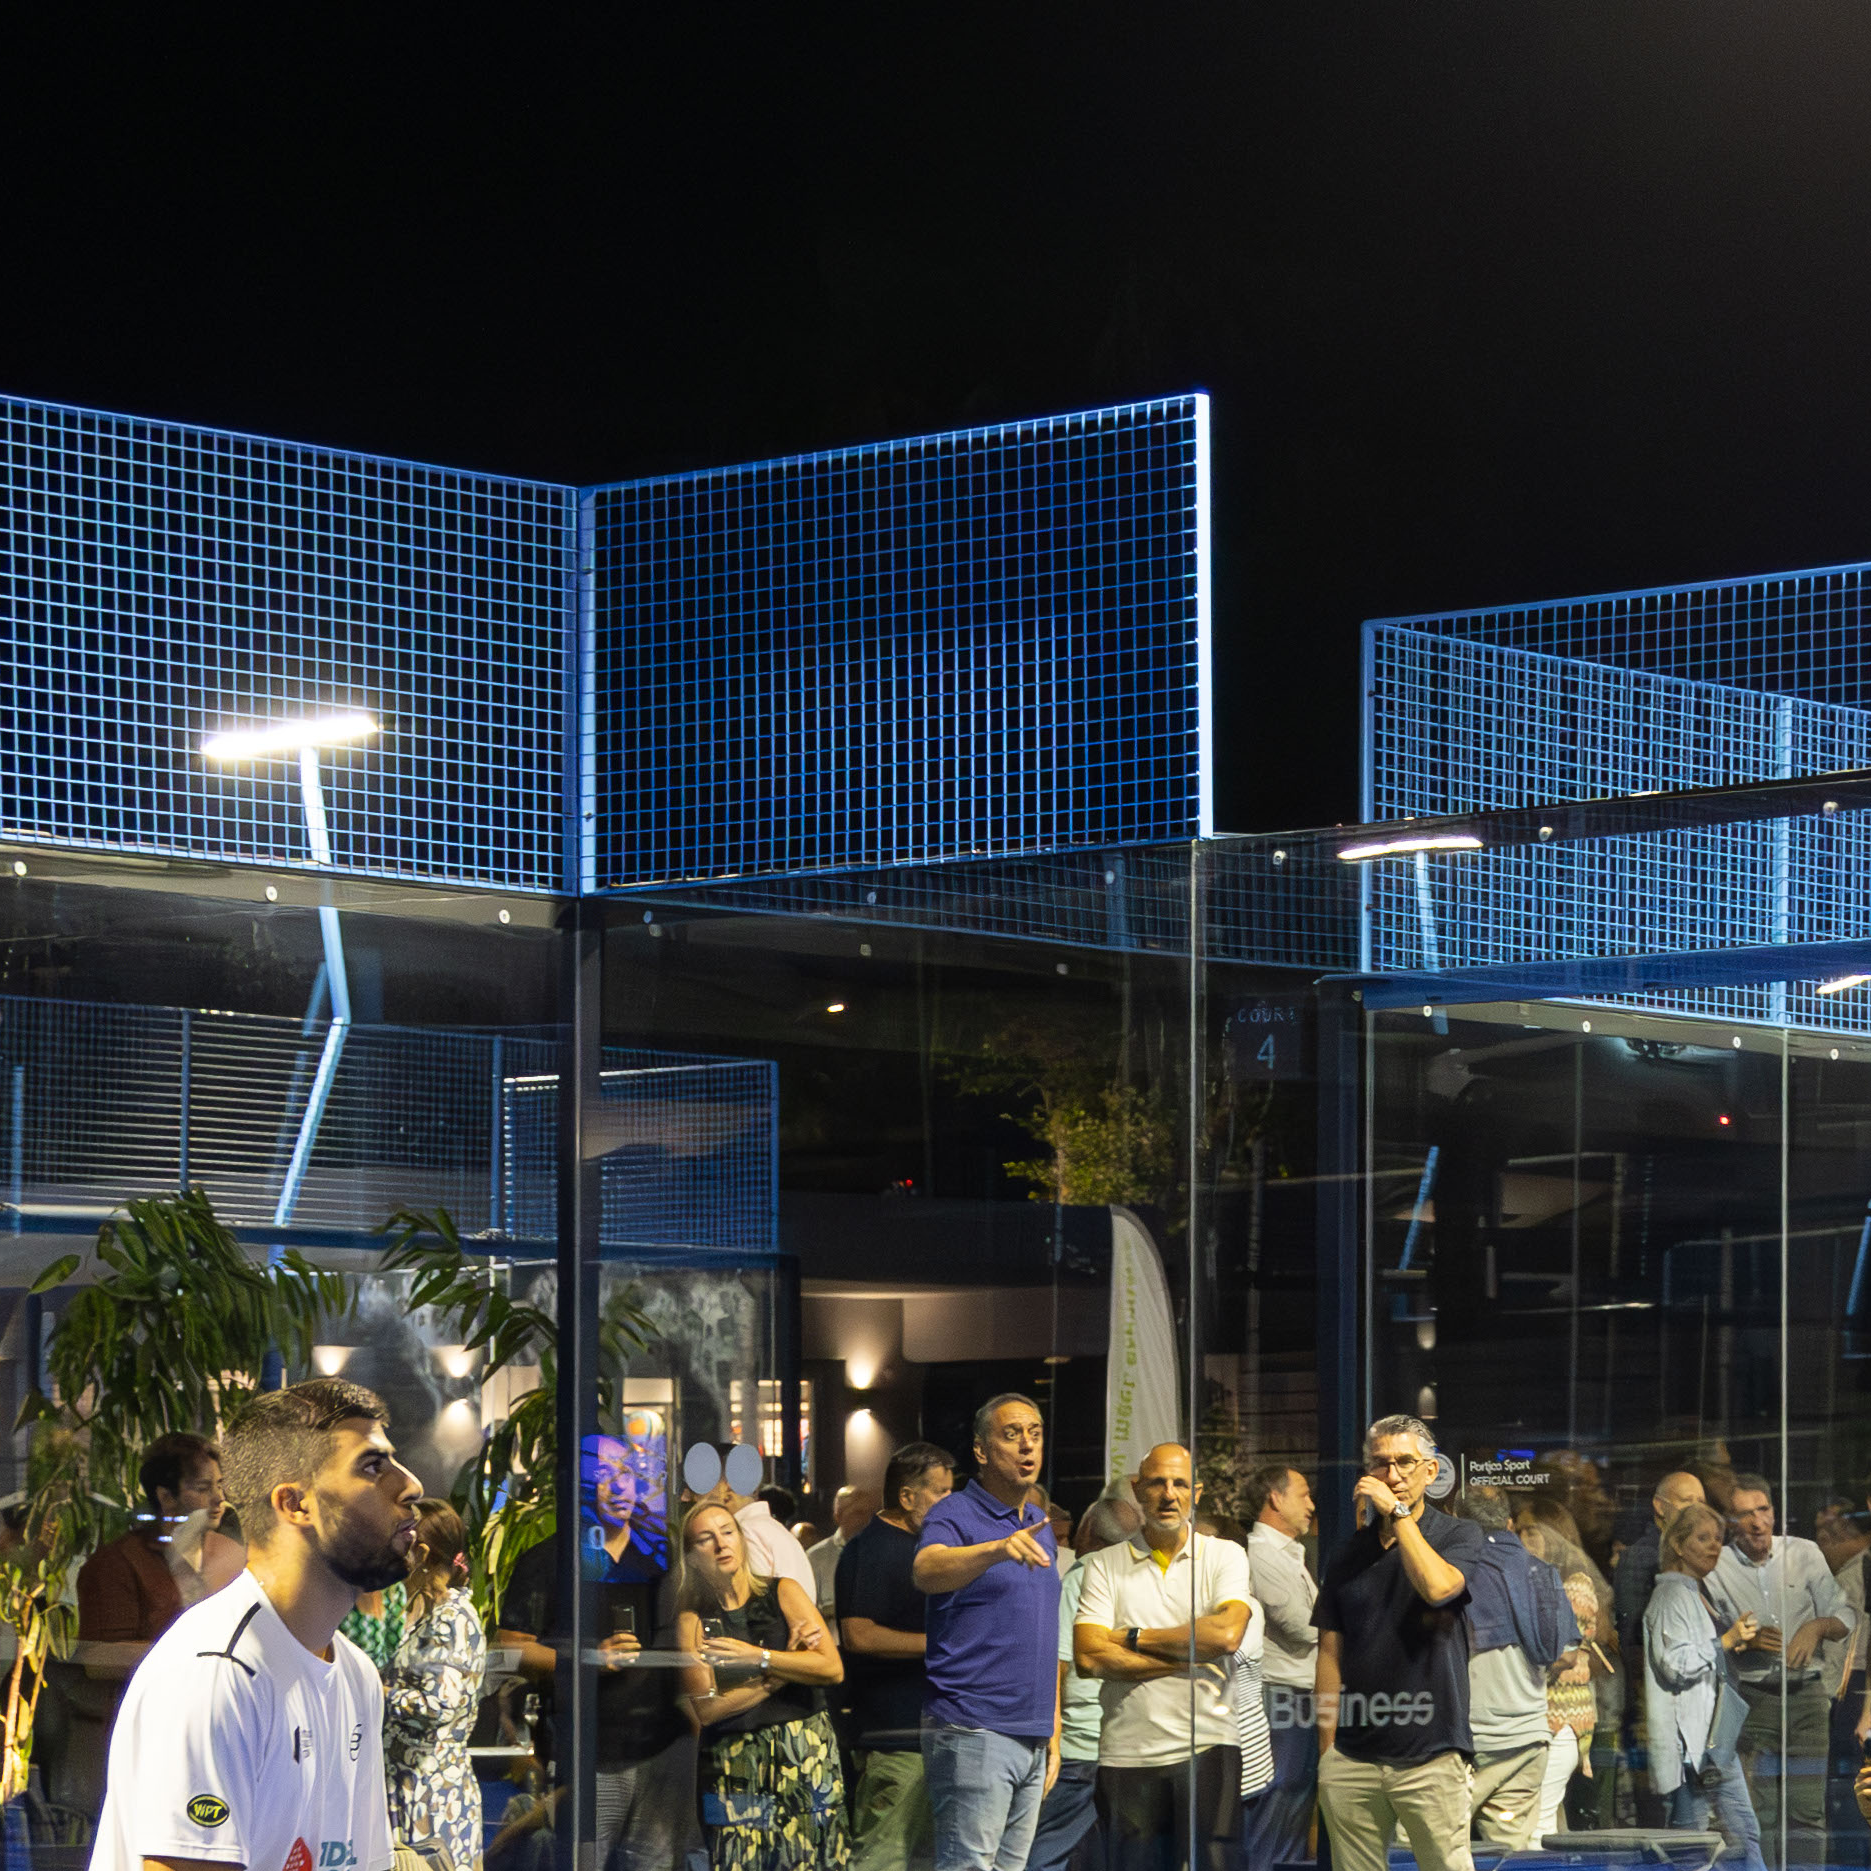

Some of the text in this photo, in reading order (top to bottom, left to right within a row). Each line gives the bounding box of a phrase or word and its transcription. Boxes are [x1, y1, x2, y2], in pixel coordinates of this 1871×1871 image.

[1257, 1033, 1275, 1069] 4
[1504, 1459, 1531, 1472] Sport
[1469, 1473, 1550, 1487] OFFICIAL COURT
[1267, 1685, 1435, 1731] Business
[193, 1803, 223, 1819] WPT
